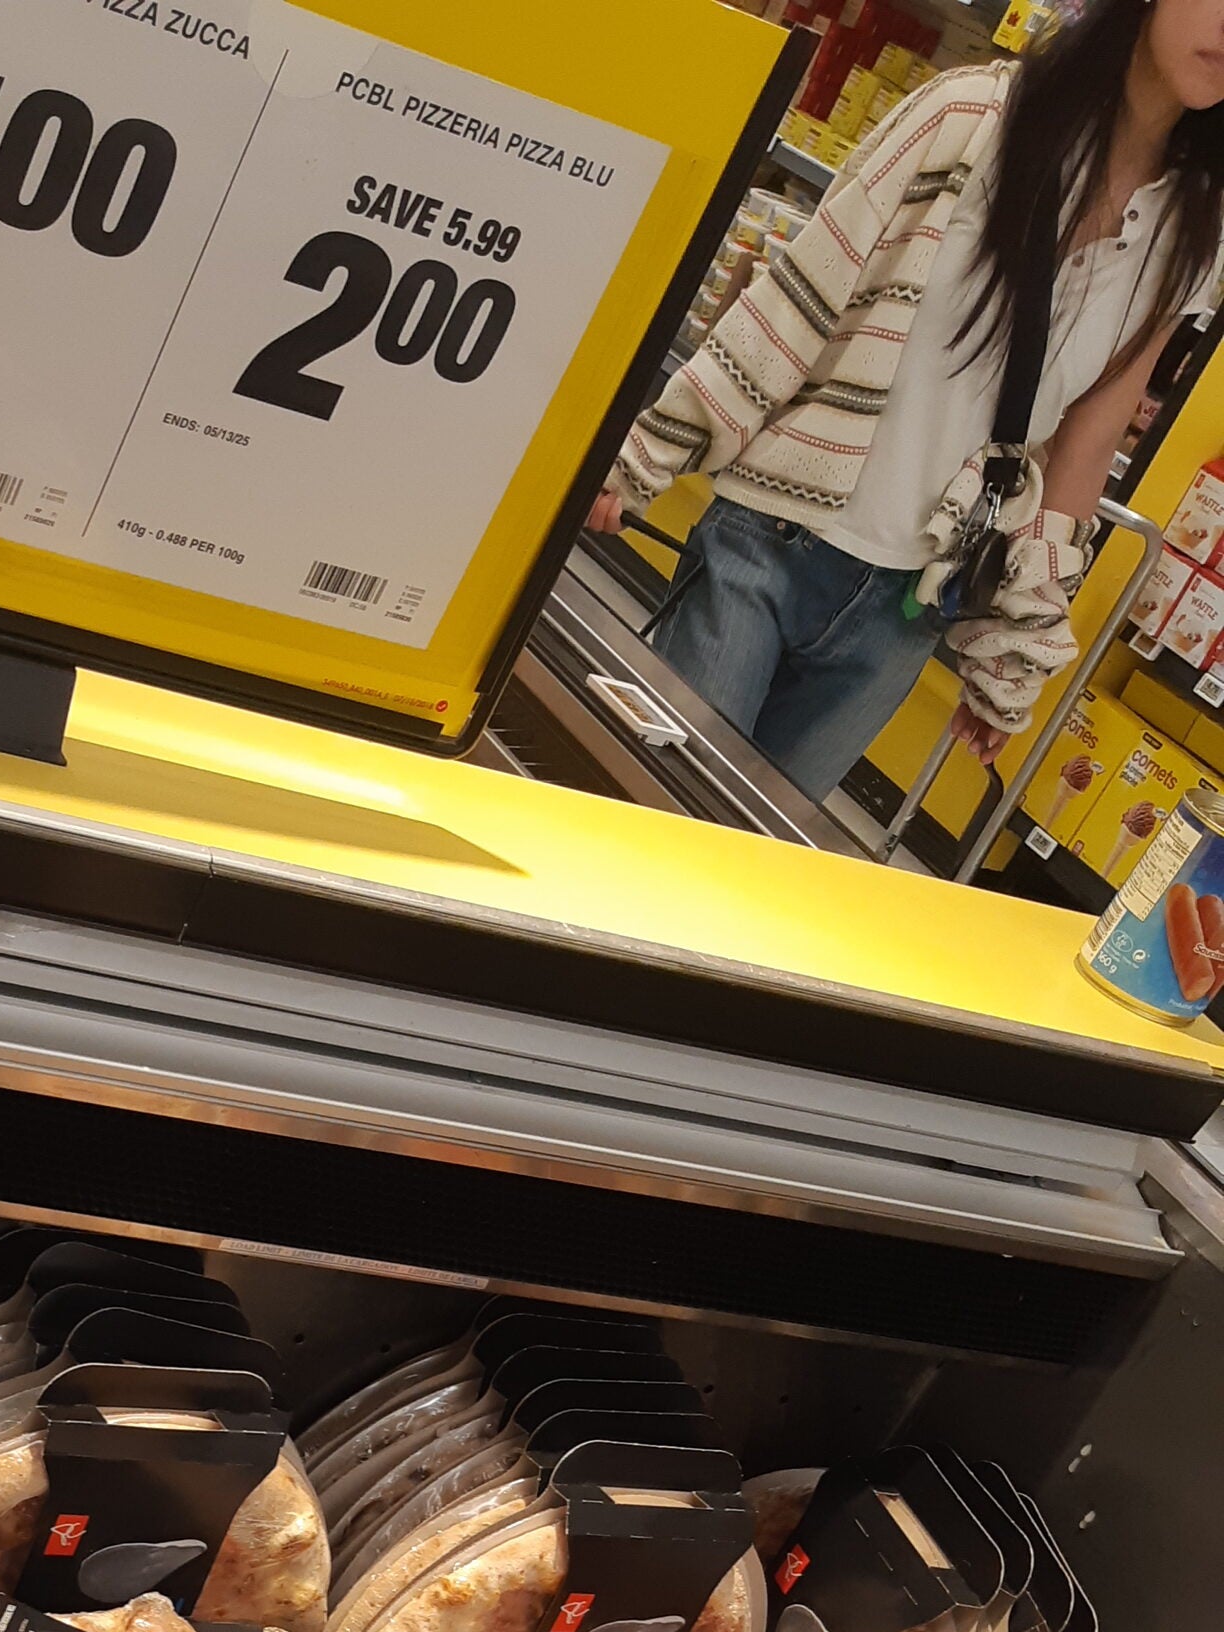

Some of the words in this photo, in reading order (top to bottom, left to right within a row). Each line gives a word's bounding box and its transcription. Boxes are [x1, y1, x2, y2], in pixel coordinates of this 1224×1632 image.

[88, 0, 155, 25] ZZA
[164, 10, 252, 59] ZUCCA
[335, 71, 397, 112] PCBL
[402, 94, 500, 149] PIZZERIA
[504, 132, 566, 171] PIZZA
[569, 155, 615, 189] BLU
[346, 175, 443, 238] SAVE
[442, 212, 522, 263] 5.99
[162, 412, 201, 436] ENDS:
[203, 422, 251, 448] 05/13/25
[115, 517, 146, 538] 410g
[154, 527, 188, 547] 0.488
[188, 537, 215, 555] PER
[216, 545, 245, 565] 100g
[1152, 568, 1173, 588] AFFLE
[1131, 748, 1179, 793] cornets
[1095, 951, 1113, 966] 160
[1107, 963, 1117, 974] g
